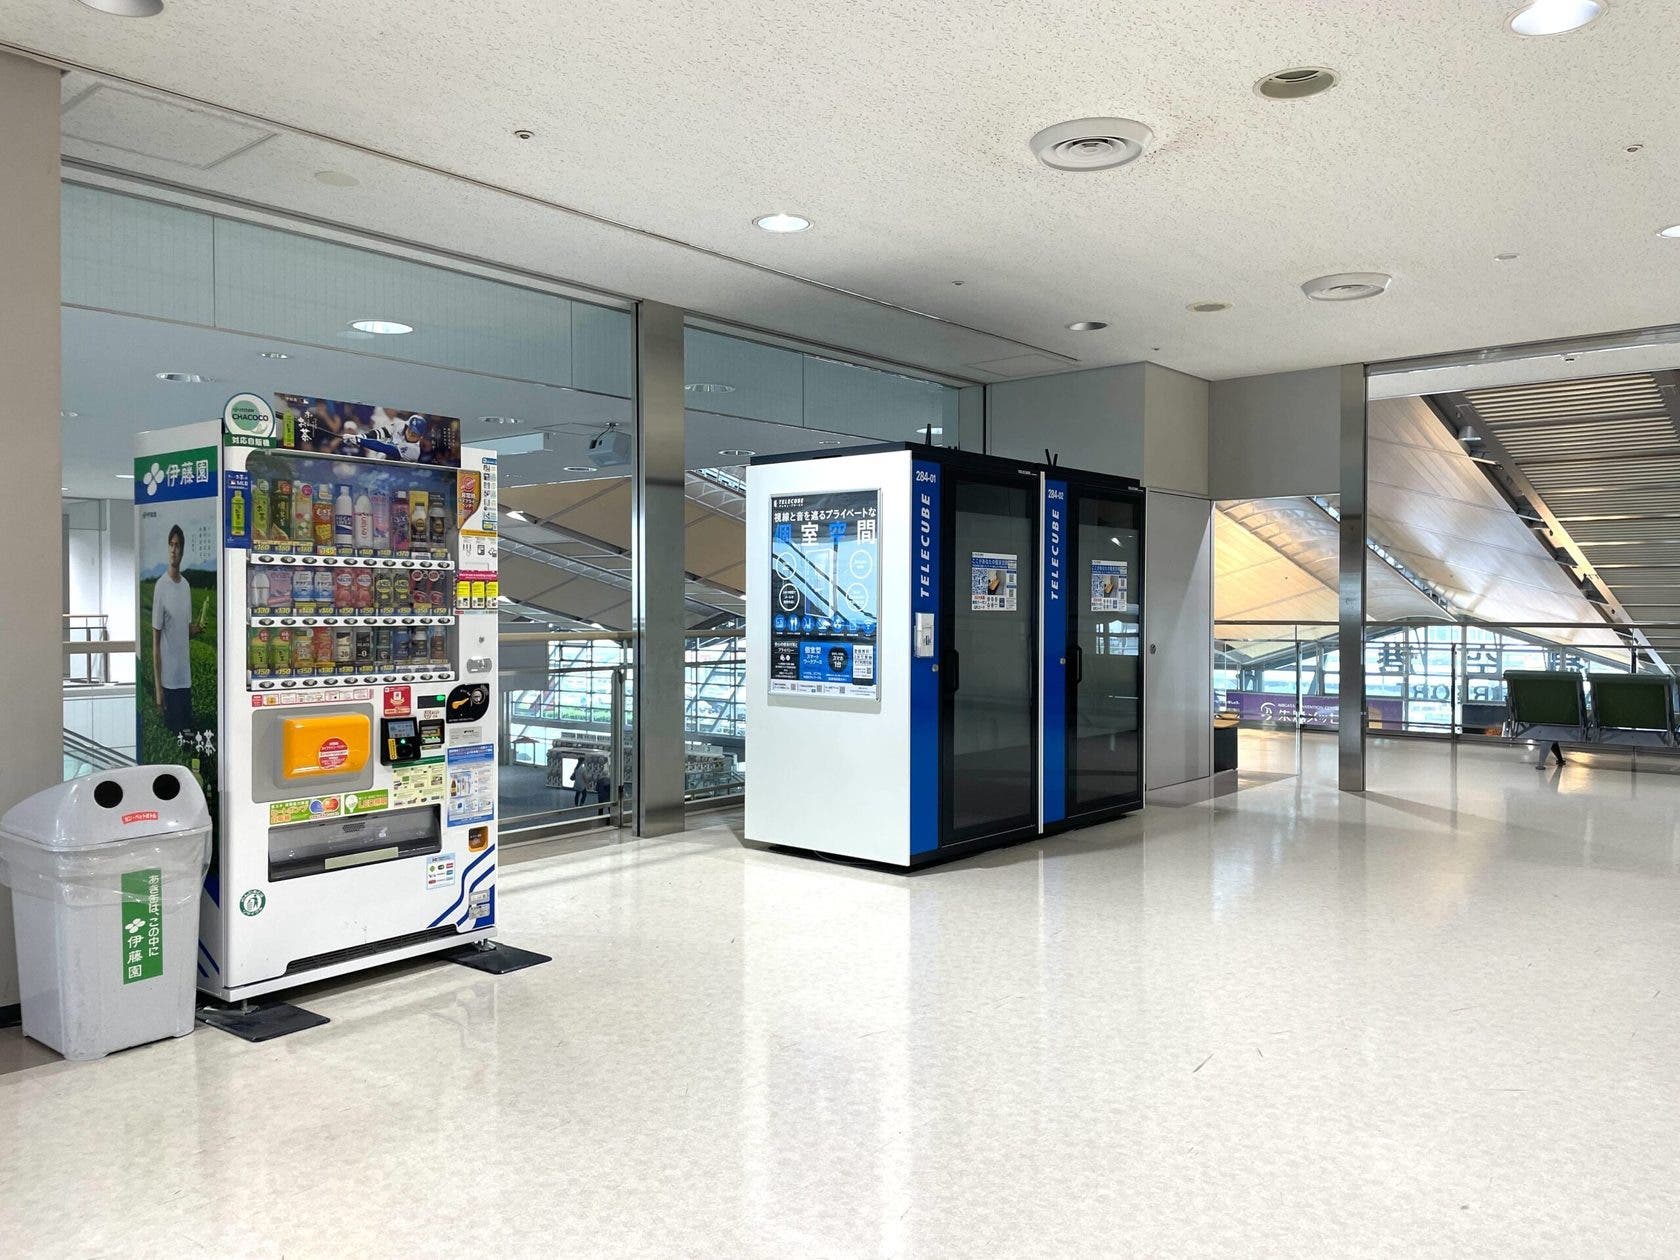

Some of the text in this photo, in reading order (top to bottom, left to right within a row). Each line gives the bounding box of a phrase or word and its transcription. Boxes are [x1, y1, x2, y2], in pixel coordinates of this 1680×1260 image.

[231, 413, 269, 422] CHACOCO
[231, 436, 270, 447] 対応自販機
[166, 459, 209, 487] 伊藤園
[916, 470, 936, 483] 284-01
[1048, 489, 1064, 500] 284-02
[773, 507, 877, 522] 視線と音を遮るプライベートな
[920, 494, 930, 598] TELECUBE
[1051, 509, 1060, 600] TELECUBE
[127, 934, 143, 979] 伊藤園
